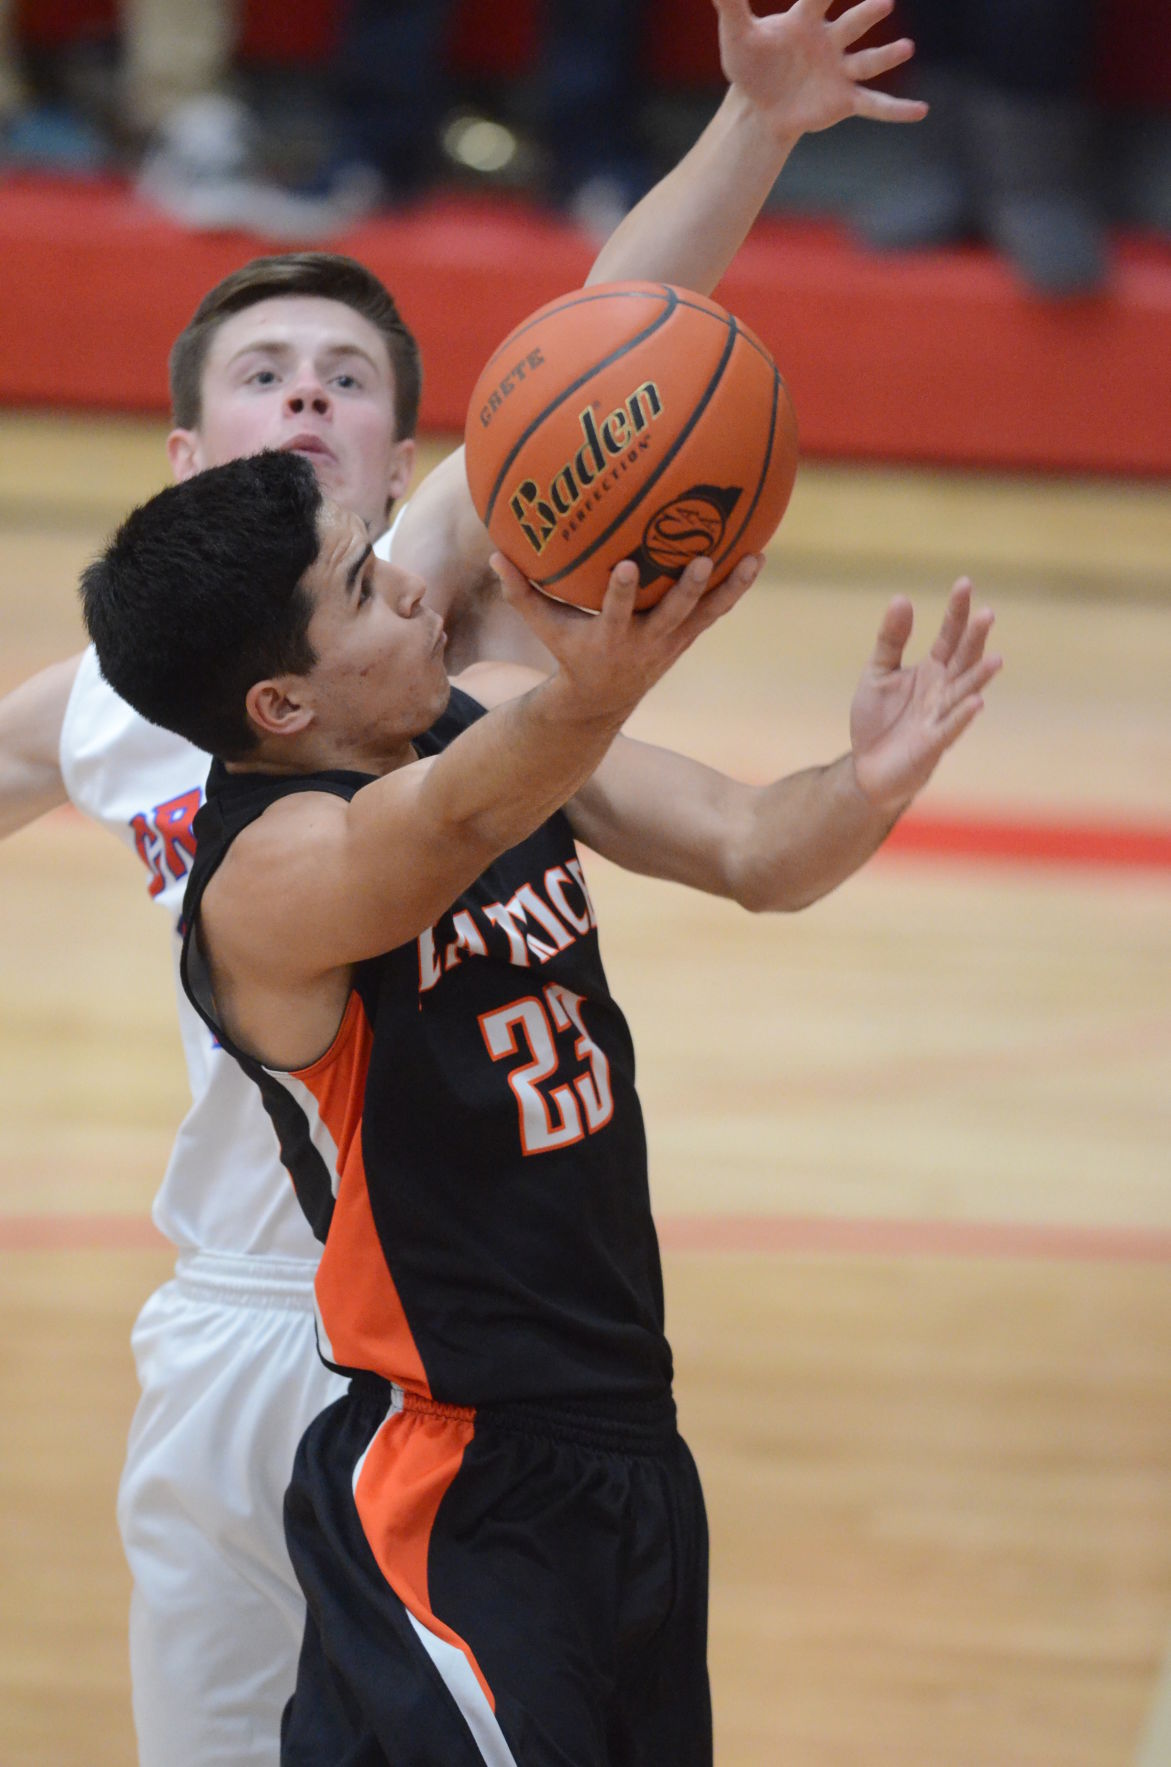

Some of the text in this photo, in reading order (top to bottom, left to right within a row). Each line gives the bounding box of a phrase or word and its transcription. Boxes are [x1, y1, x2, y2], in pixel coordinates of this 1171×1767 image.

[509, 380, 663, 556] Baden
[562, 438, 649, 541] PERFECTION
[477, 981, 615, 1157] 23
